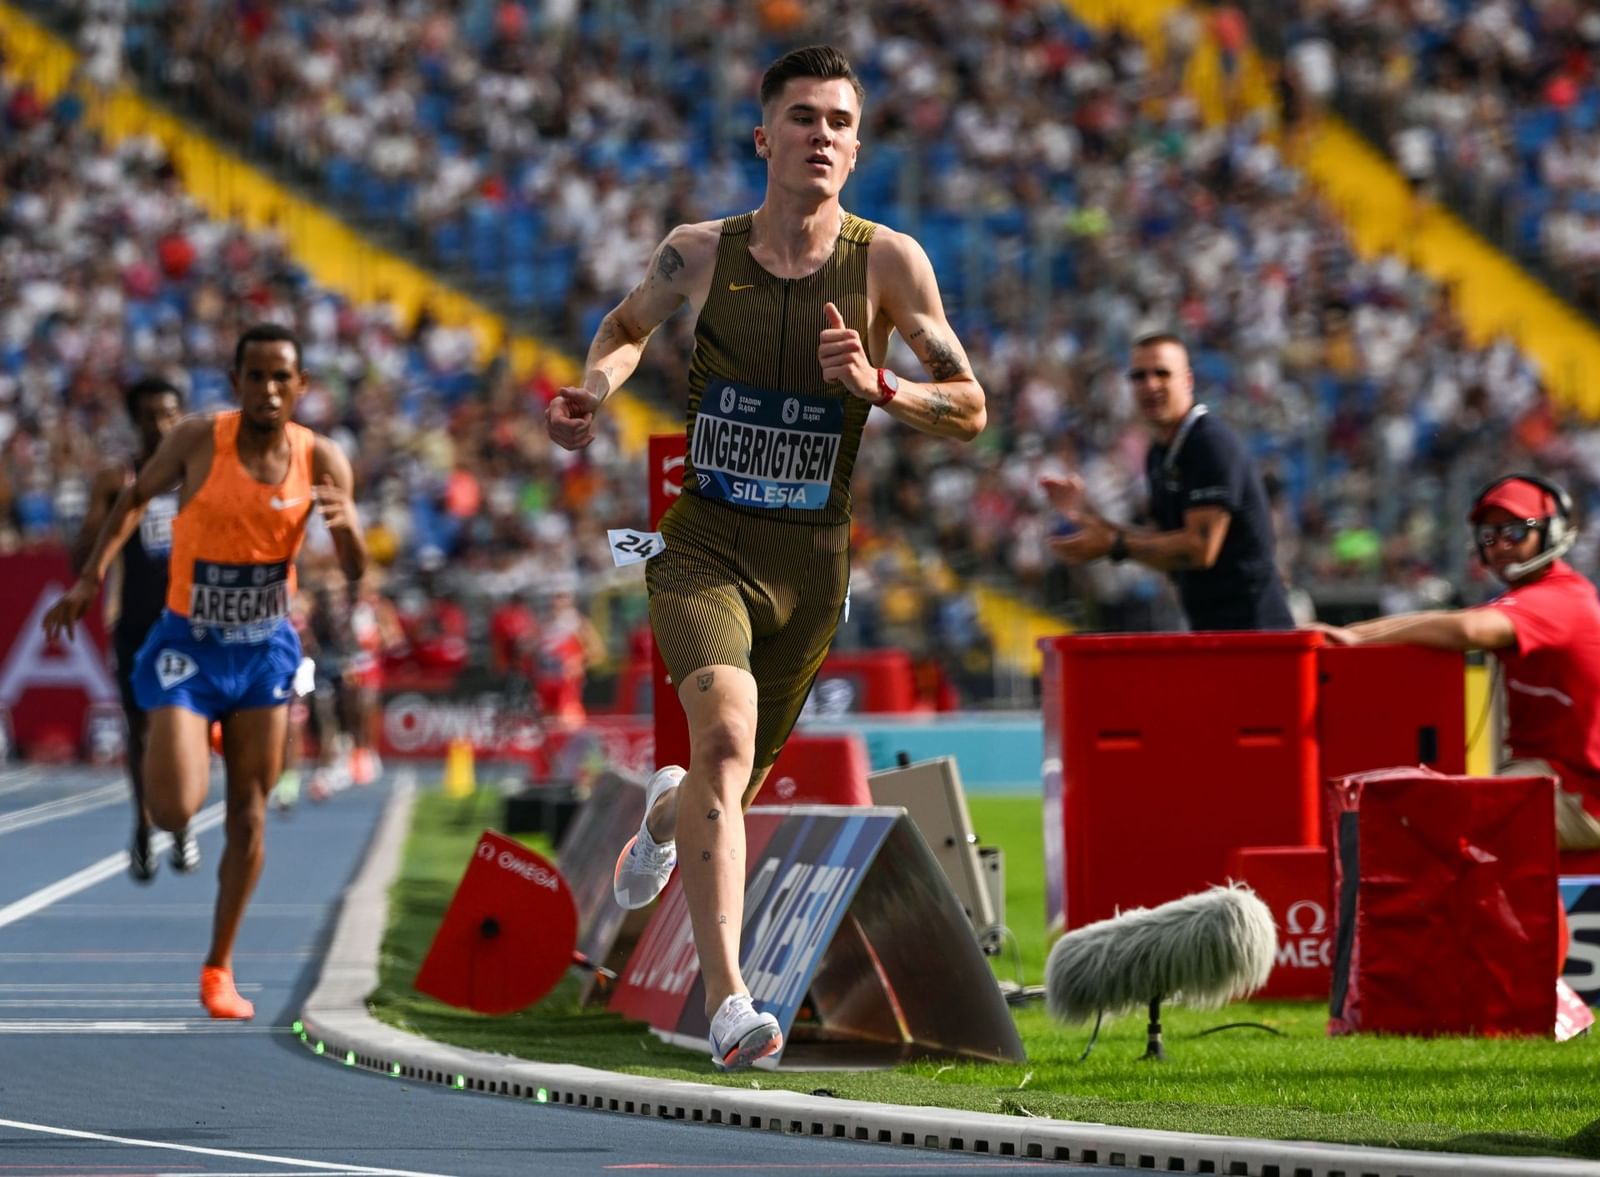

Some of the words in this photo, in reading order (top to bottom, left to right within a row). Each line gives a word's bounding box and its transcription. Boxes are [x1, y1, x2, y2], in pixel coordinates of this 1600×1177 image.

[693, 416, 838, 482] INGEBRIGTSEN
[732, 481, 807, 504] SILESIA
[615, 534, 653, 558] 24
[498, 851, 559, 892] OMEGA
[739, 862, 856, 1008] SILESIA
